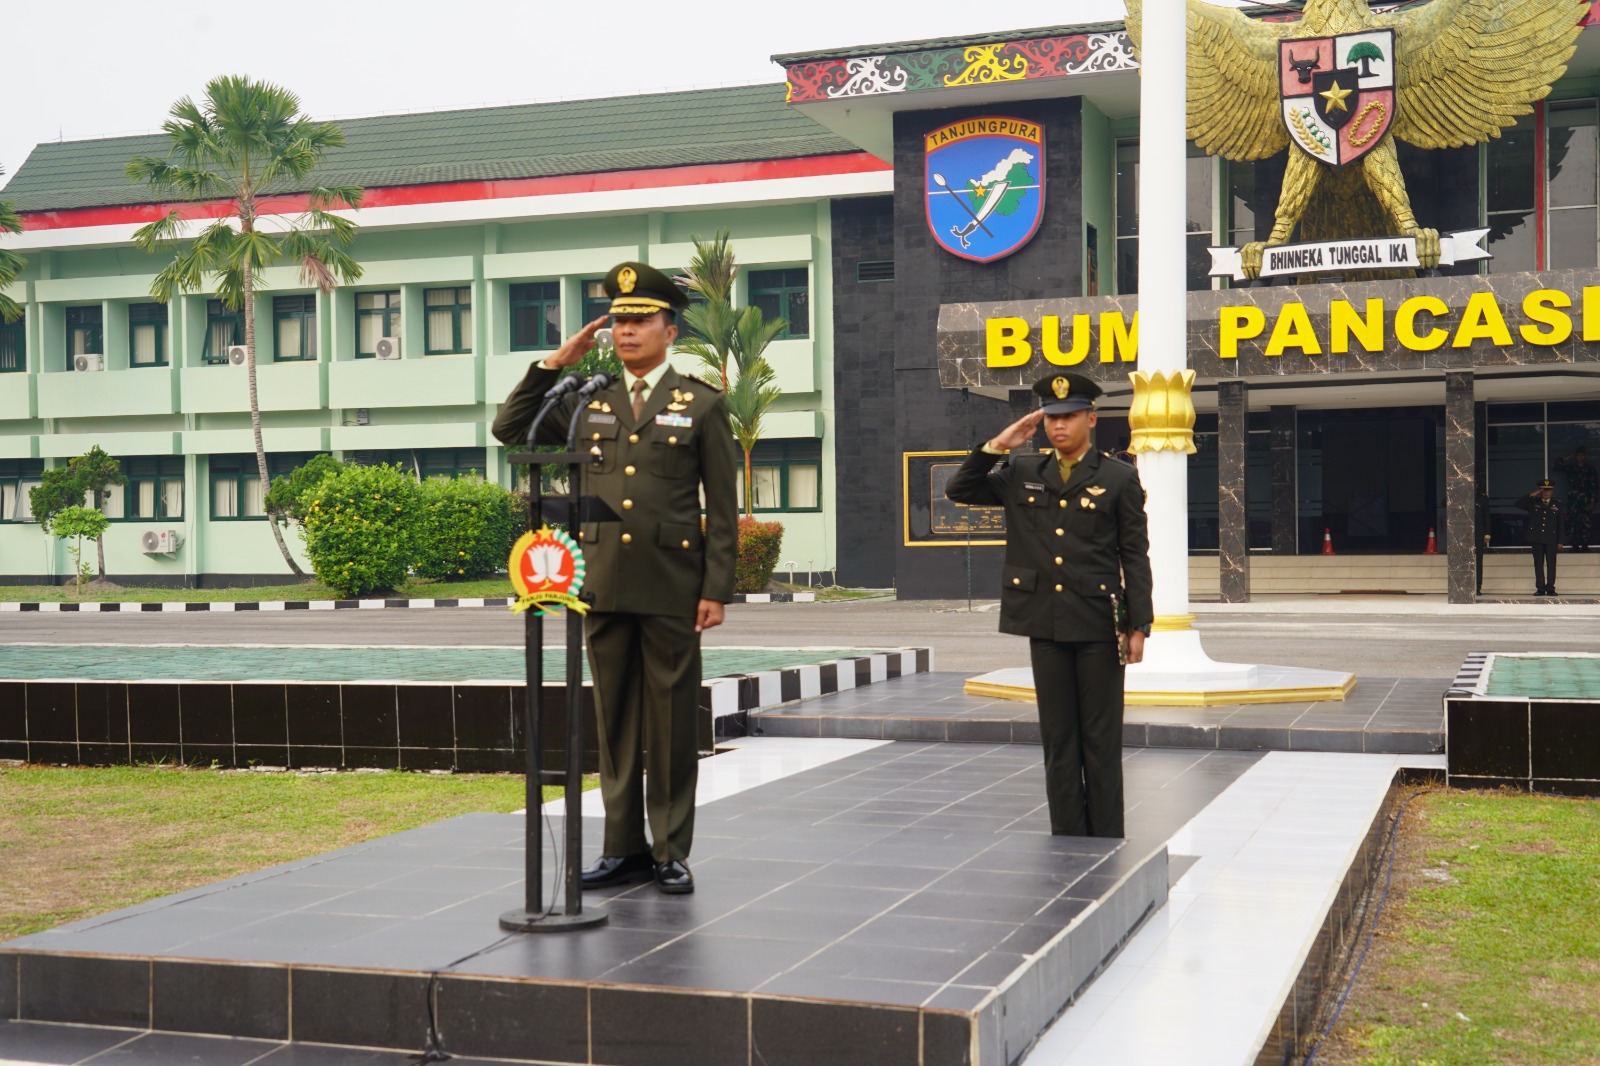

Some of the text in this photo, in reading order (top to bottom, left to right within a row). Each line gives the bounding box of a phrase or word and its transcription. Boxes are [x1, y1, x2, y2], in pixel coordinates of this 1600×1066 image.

[930, 120, 1037, 146] TANJUNGPURA
[1270, 243, 1408, 271] BHINNEKA TUNGGAL IKA
[985, 310, 1139, 368] BUM
